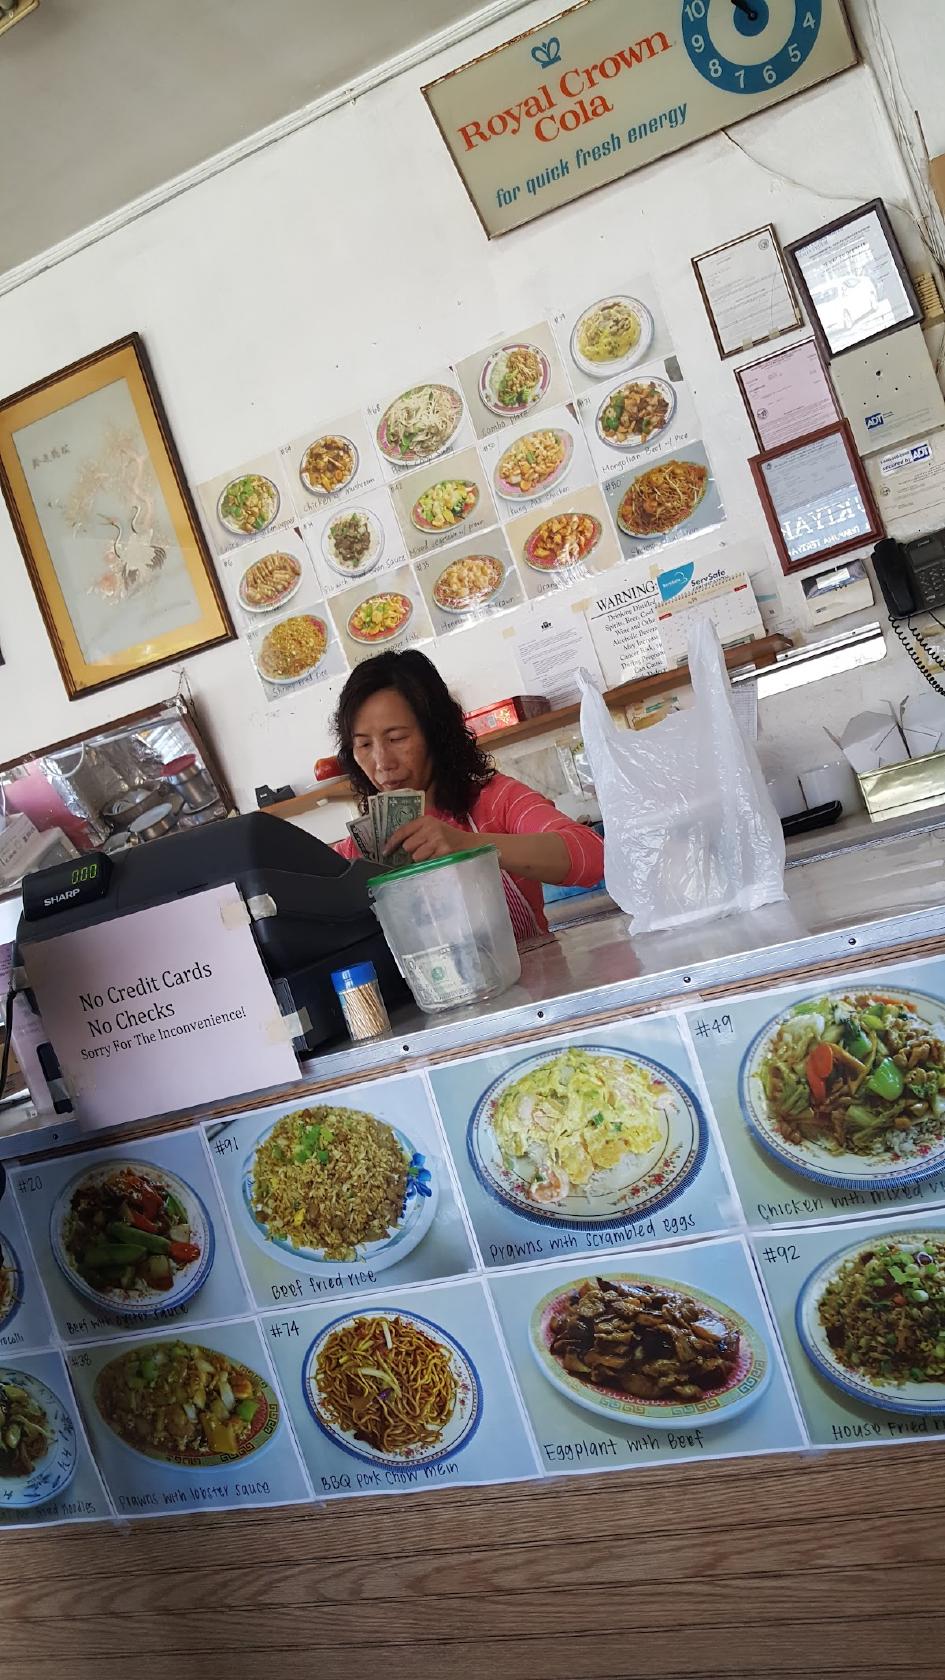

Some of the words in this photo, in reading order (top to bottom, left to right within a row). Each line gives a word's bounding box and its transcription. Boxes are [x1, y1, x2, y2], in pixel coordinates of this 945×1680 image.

[802, 11, 816, 29] 4
[691, 34, 705, 53] 9
[788, 43, 801, 63] 5
[709, 58, 722, 78] 8
[763, 65, 777, 84] 6
[735, 69, 745, 89] 7
[458, 85, 558, 151] Royal
[559, 31, 673, 98] Crown
[534, 95, 614, 143] Cola
[496, 184, 521, 208] for
[526, 158, 570, 196] quick
[575, 132, 622, 169] fresh
[628, 102, 688, 144] energy
[691, 569, 726, 587] ServSafe
[44, 888, 80, 907] SHARP
[79, 992, 104, 1013] No
[107, 976, 160, 1005] Credit
[162, 962, 213, 989] Cards
[88, 1019, 113, 1038] No
[115, 1002, 175, 1031] Checks
[694, 1015, 734, 1038] #49
[81, 1044, 111, 1061] Sorry
[113, 1038, 133, 1053] For
[134, 1031, 157, 1048] The
[158, 1007, 247, 1041] Inconvenience!
[214, 1137, 239, 1156] #91
[18, 1175, 42, 1194] #20
[757, 1198, 824, 1221] Chicken
[549, 1233, 578, 1250] with
[762, 1246, 801, 1264] #92
[271, 1279, 304, 1300] Beef
[309, 1272, 344, 1295] fried
[348, 1269, 377, 1287] rice
[270, 1320, 300, 1338] #74
[543, 1438, 617, 1461] Eggplant
[627, 1434, 660, 1453] with
[667, 1429, 706, 1450] Beef
[321, 1474, 352, 1491] BBQ
